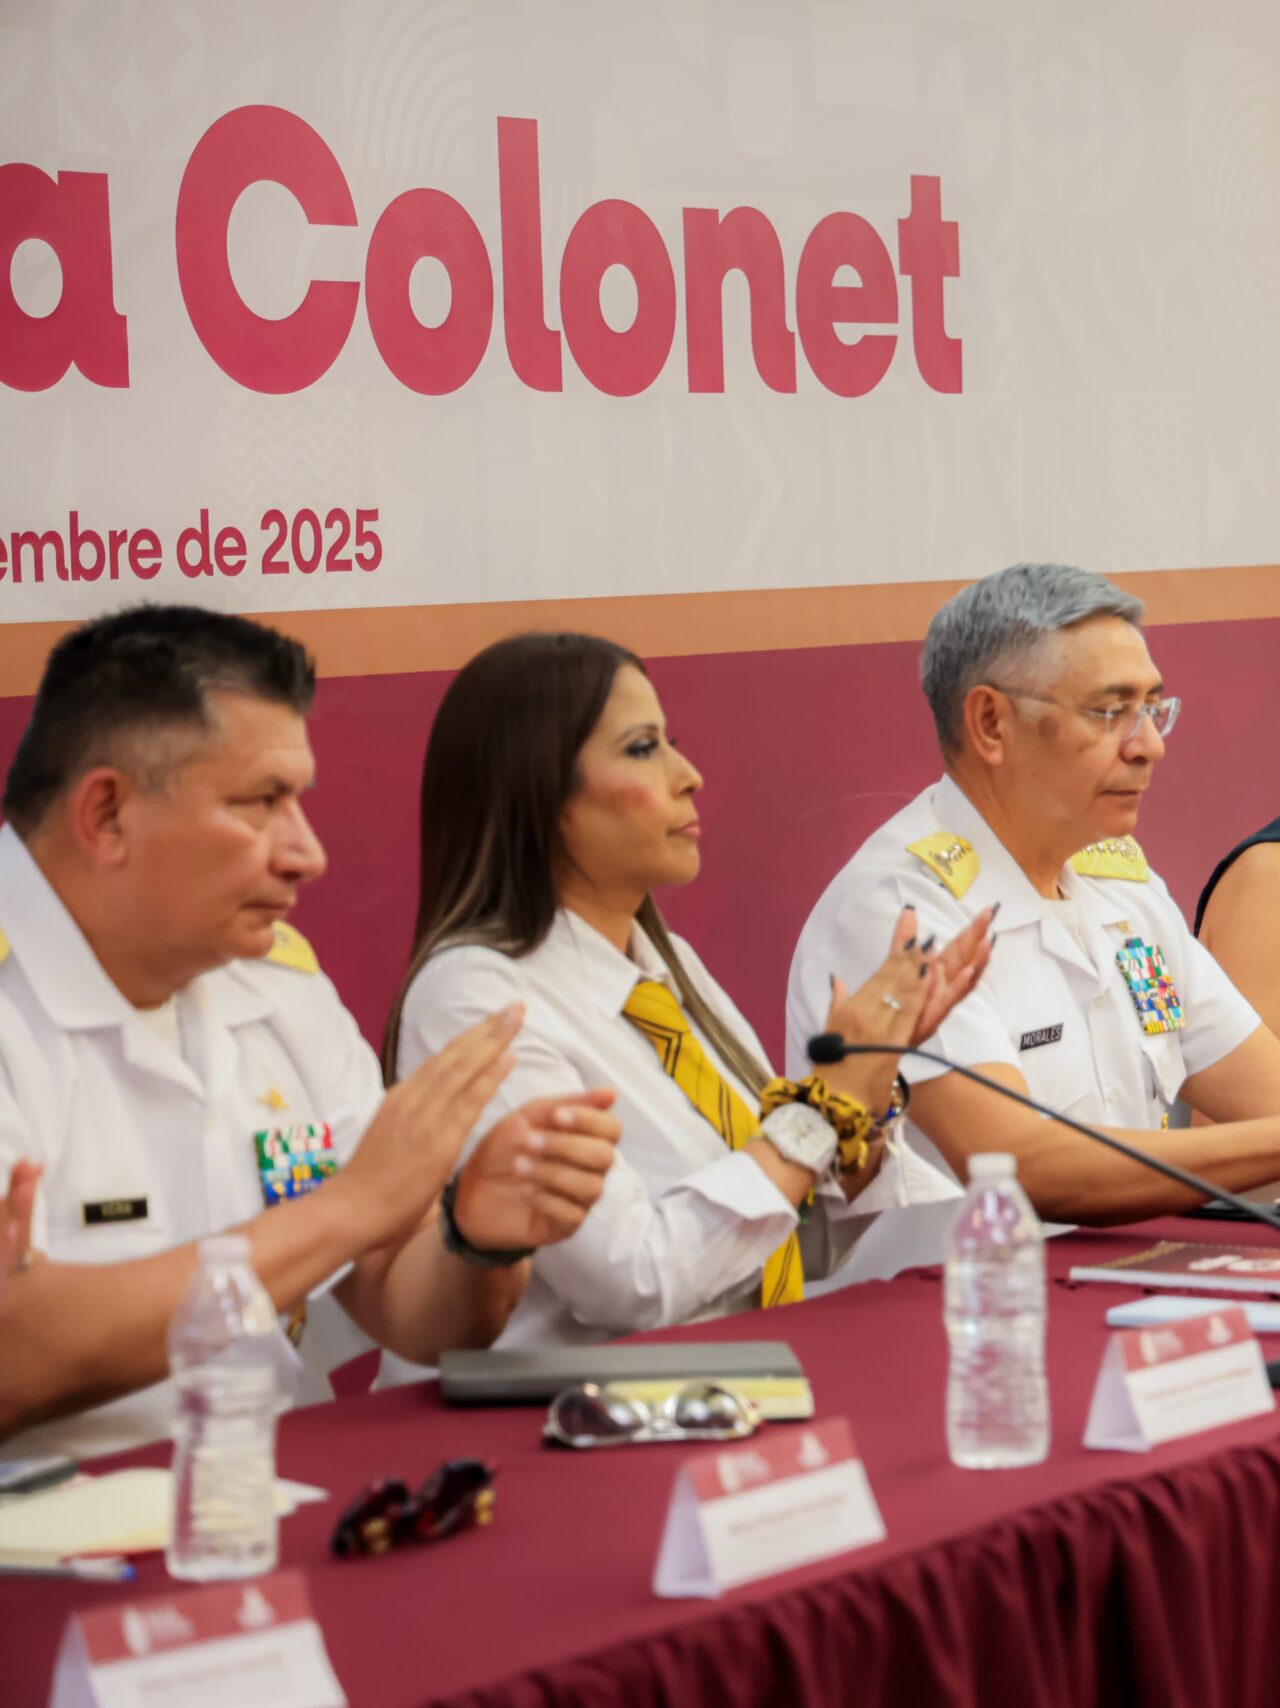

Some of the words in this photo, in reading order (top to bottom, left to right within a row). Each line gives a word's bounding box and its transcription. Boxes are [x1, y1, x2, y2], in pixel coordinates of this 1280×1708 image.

[175, 104, 964, 398] Colonet
[0, 508, 163, 583] mbre
[177, 508, 248, 578] de
[260, 507, 383, 575] 2025
[1022, 1026, 1061, 1047] MORALES
